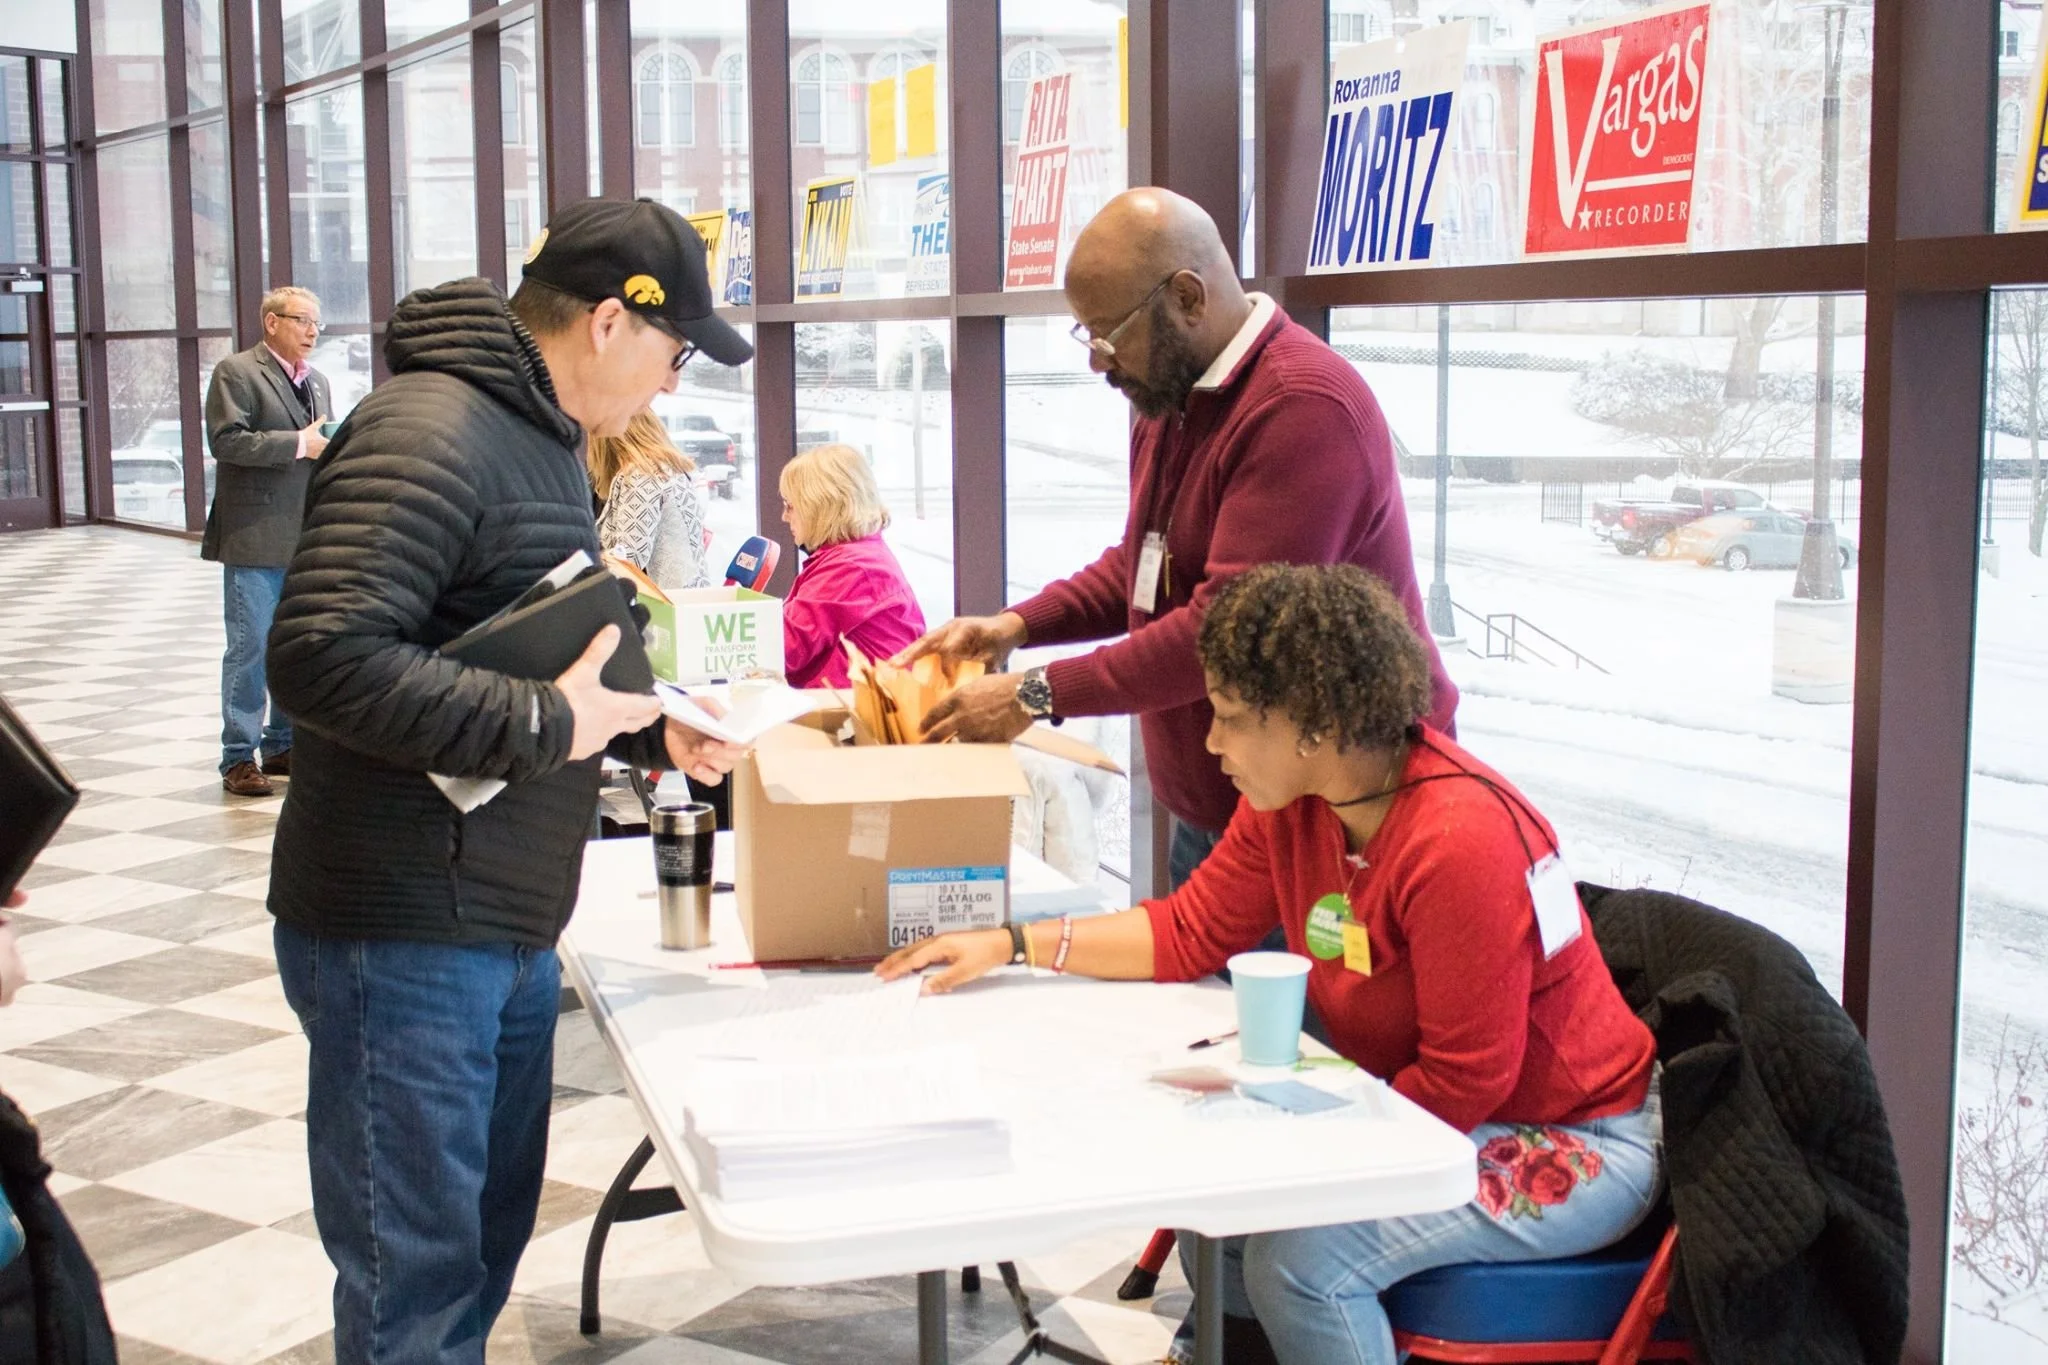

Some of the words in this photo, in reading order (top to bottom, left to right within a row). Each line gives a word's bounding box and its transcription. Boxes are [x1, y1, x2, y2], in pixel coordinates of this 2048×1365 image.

[1334, 69, 1401, 104] Roxanna
[1026, 72, 1072, 148] RITA
[1545, 25, 1703, 229] Vargas
[1013, 151, 1068, 228] HART
[1310, 91, 1454, 267] MORITZ
[1594, 201, 1689, 228] RECORDER
[1011, 240, 1029, 256] State
[1030, 237, 1055, 255] Senate
[703, 612, 757, 644] WE
[704, 653, 758, 674] LIVES
[938, 893, 992, 904] CATALOG
[938, 914, 967, 924] WHITE
[970, 913, 996, 923] WOVE
